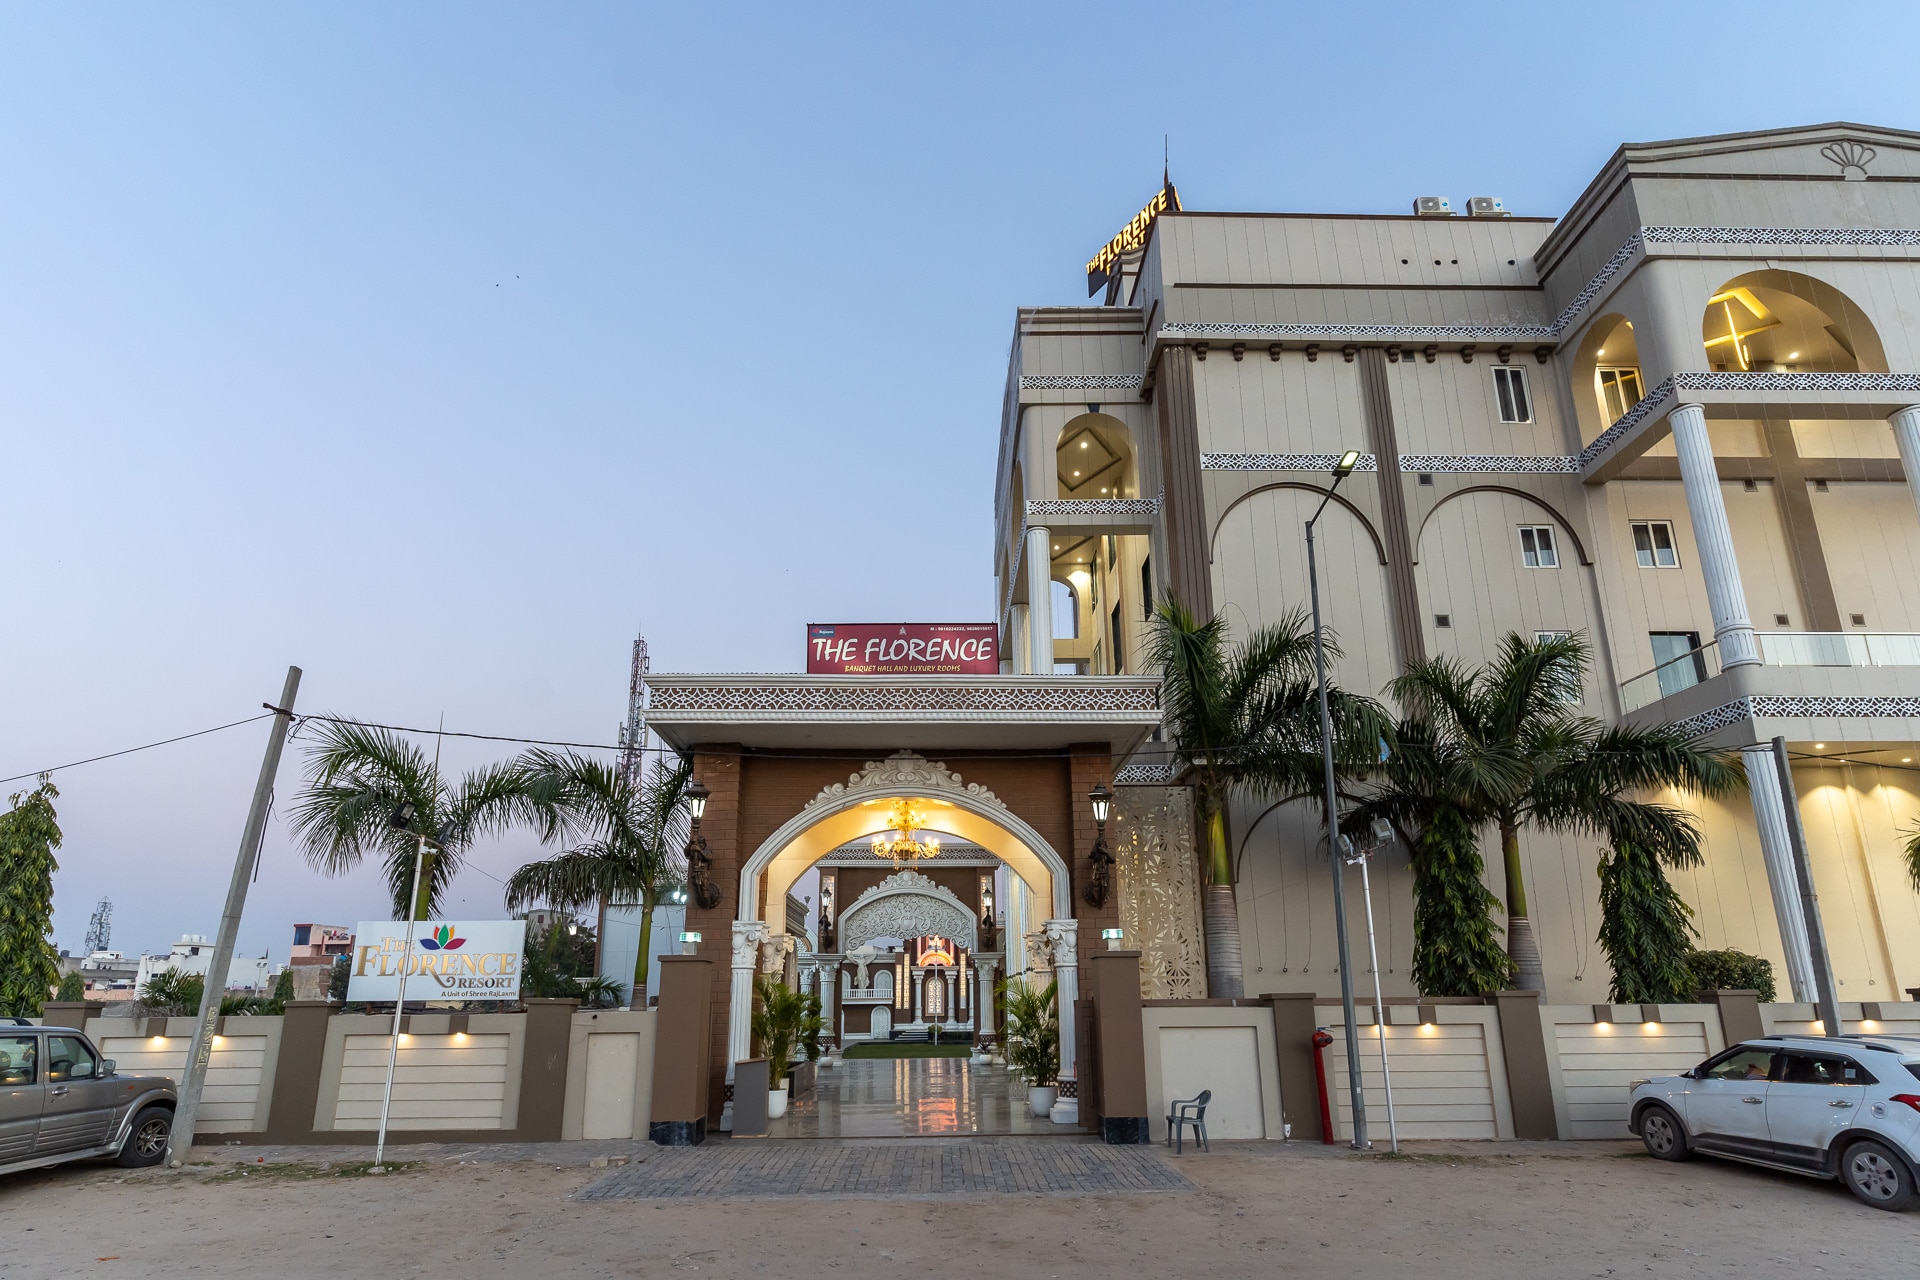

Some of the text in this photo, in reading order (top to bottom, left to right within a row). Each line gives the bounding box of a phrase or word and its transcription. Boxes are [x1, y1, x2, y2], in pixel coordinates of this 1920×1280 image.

[1086, 254, 1100, 274] THE
[1099, 188, 1167, 272] FLORENCE
[812, 637, 993, 663] THE FLORENCE
[353, 945, 517, 986] FLORENCE
[457, 977, 515, 989] RESORT
